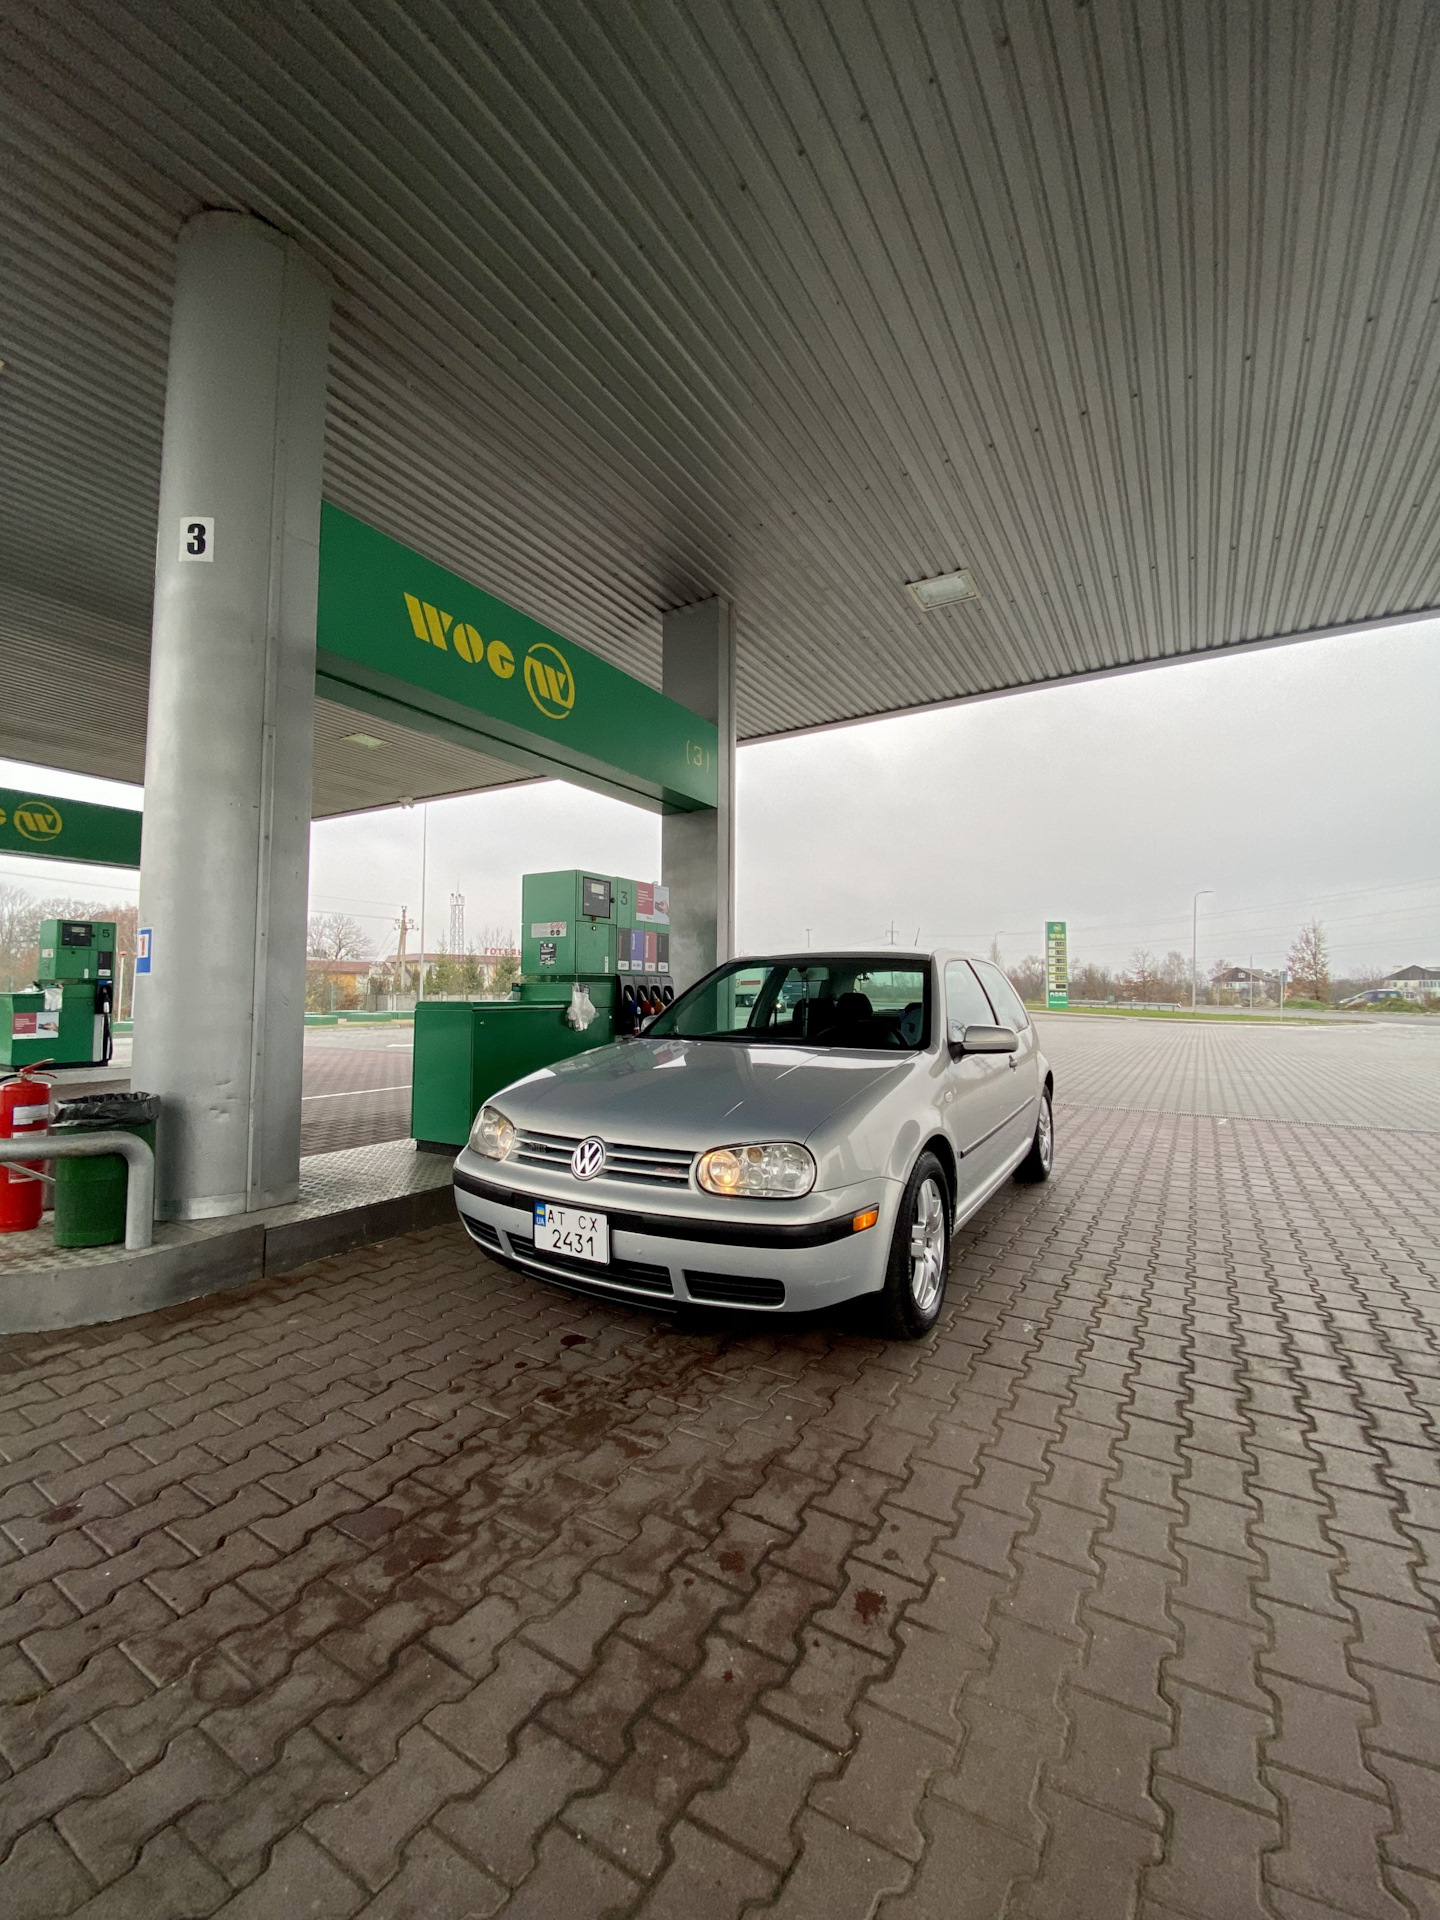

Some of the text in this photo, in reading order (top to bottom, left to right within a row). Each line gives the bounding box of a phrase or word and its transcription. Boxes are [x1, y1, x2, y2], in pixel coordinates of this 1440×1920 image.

[187, 523, 206, 555] 3
[404, 592, 516, 679] WOG
[620, 890, 629, 906] 3
[102, 929, 111, 938] 5
[536, 1216, 545, 1226] UA
[547, 1209, 598, 1232] AT CX
[552, 1228, 594, 1257] 2431
